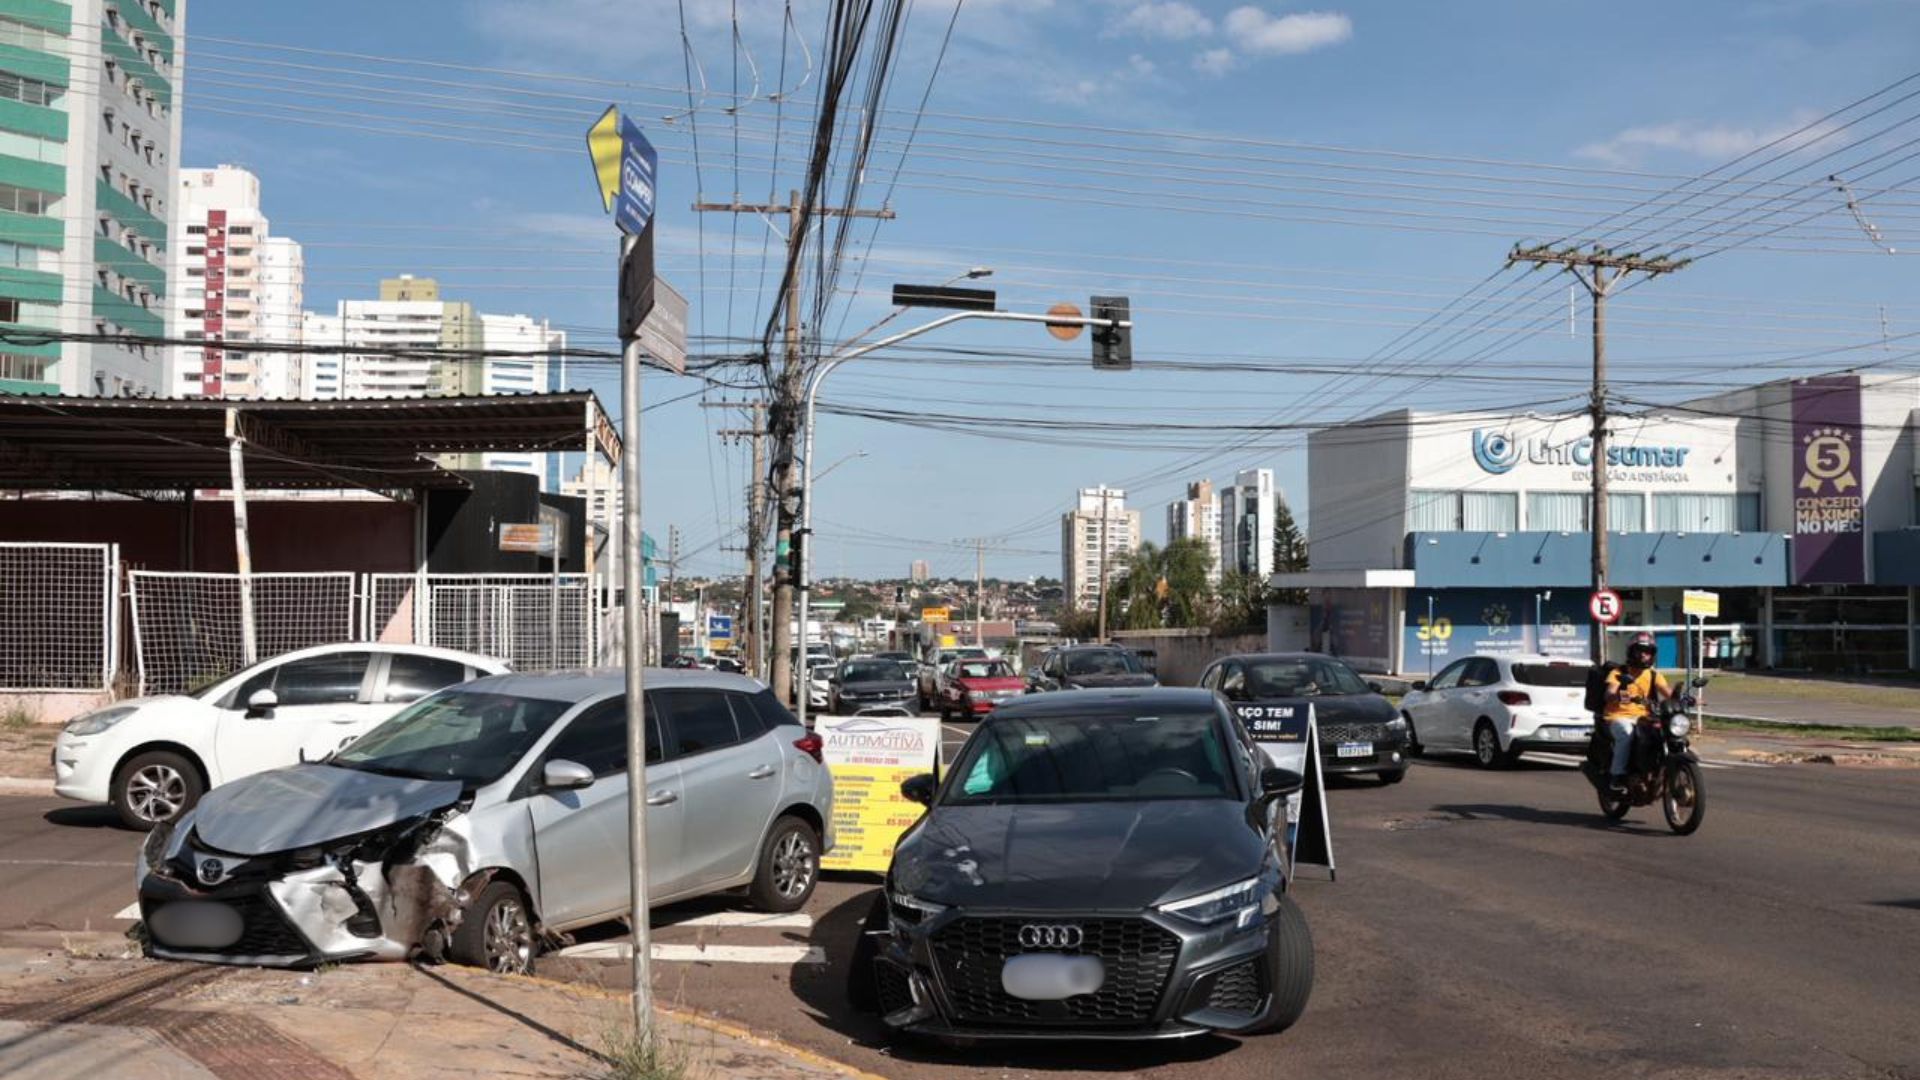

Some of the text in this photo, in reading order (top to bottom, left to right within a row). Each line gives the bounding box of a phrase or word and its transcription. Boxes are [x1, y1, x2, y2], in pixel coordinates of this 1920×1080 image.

[1528, 437, 1690, 467] UniCsumar
[1817, 443, 1841, 472] 5
[1638, 470, 1689, 483] DISTÂNCIA
[1796, 496, 1862, 510] CONCEITO
[1797, 520, 1862, 534] NO MEC
[1600, 596, 1612, 615] E
[1416, 617, 1452, 641] 30
[1266, 706, 1294, 718] TEM
[1253, 720, 1282, 731] SIM!
[827, 734, 924, 751] AUTOMOTIVA
